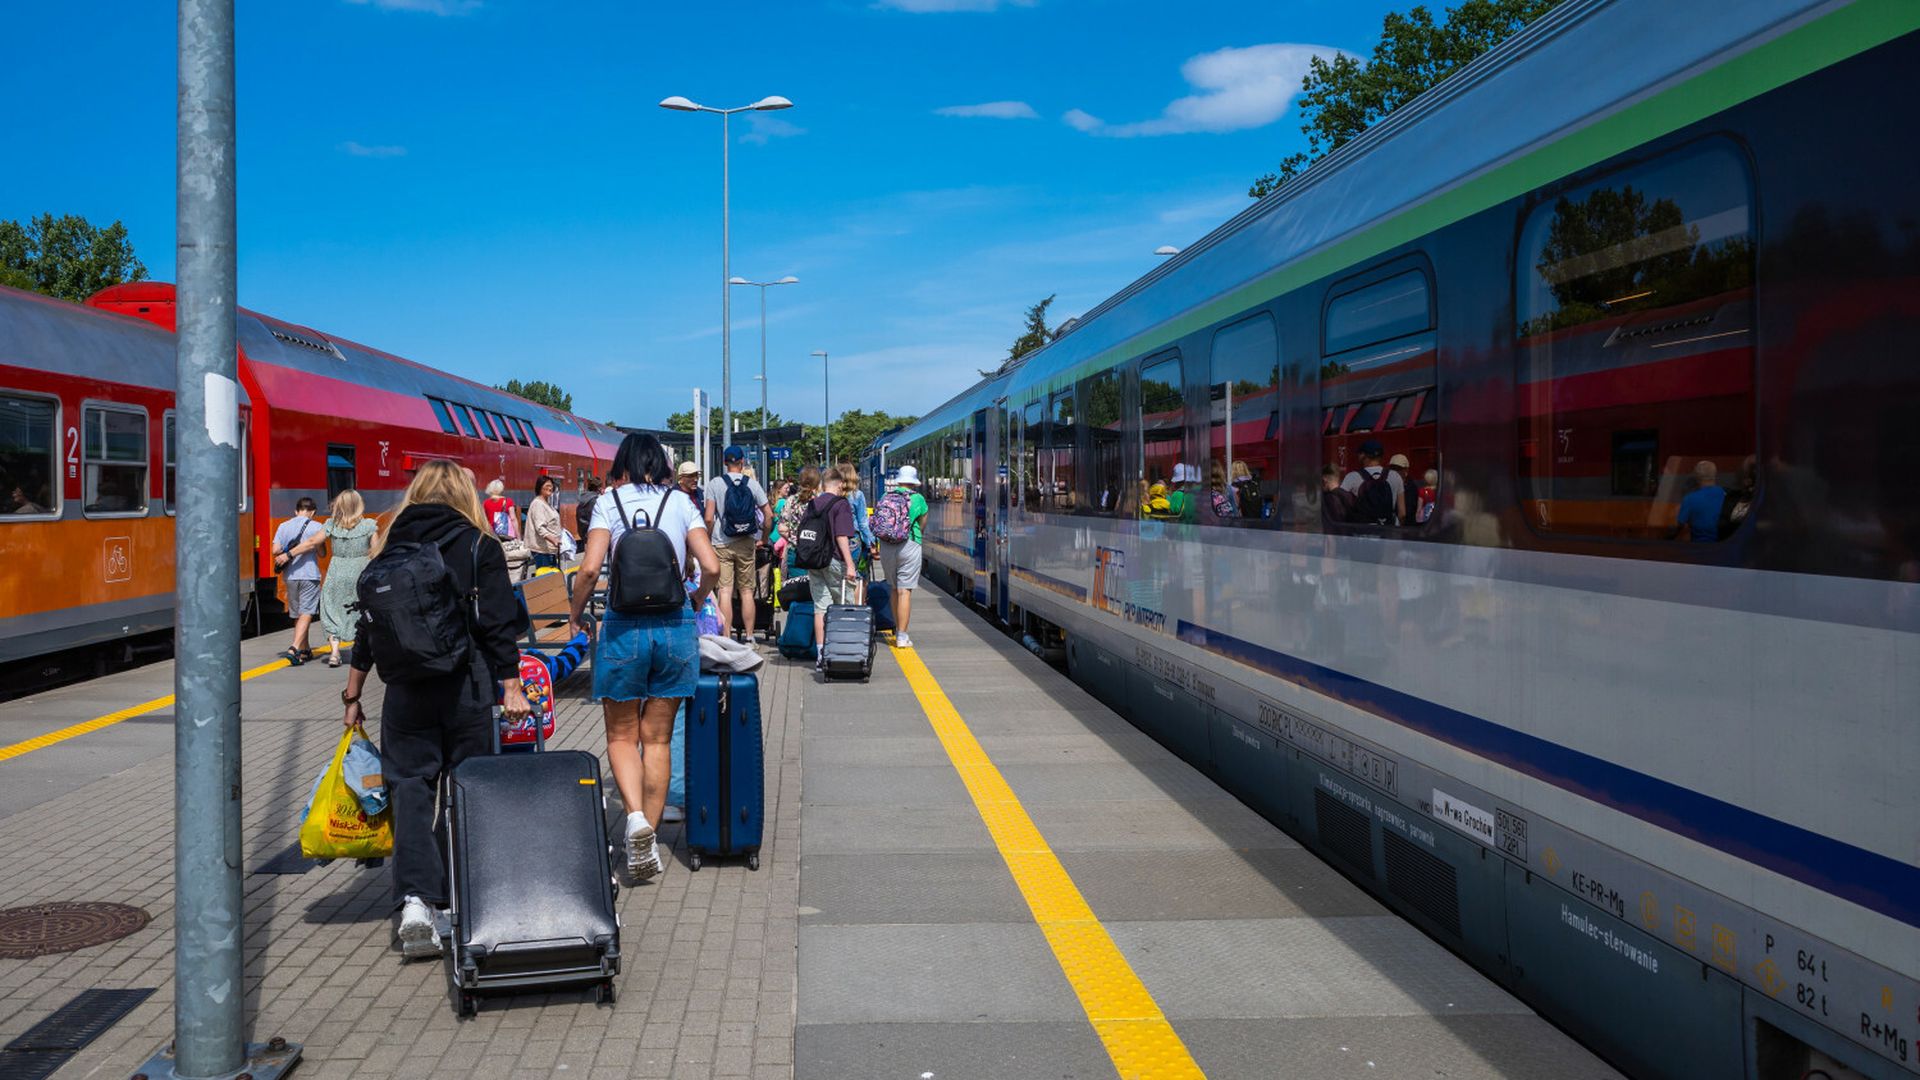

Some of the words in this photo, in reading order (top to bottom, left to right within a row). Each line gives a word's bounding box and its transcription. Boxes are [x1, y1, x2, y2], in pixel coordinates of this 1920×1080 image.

[67, 426, 78, 463] 2
[1136, 605, 1167, 634] INTERCITY
[1572, 869, 1624, 918] KE-PR-Mg
[1561, 903, 1658, 973] Hamulec-sterowanie
[1765, 934, 1774, 954] P
[1797, 949, 1815, 976] 64
[1821, 960, 1828, 982] t
[1797, 982, 1815, 1010] 82
[1821, 995, 1828, 1016] t
[1860, 1011, 1908, 1062] R+Mg
